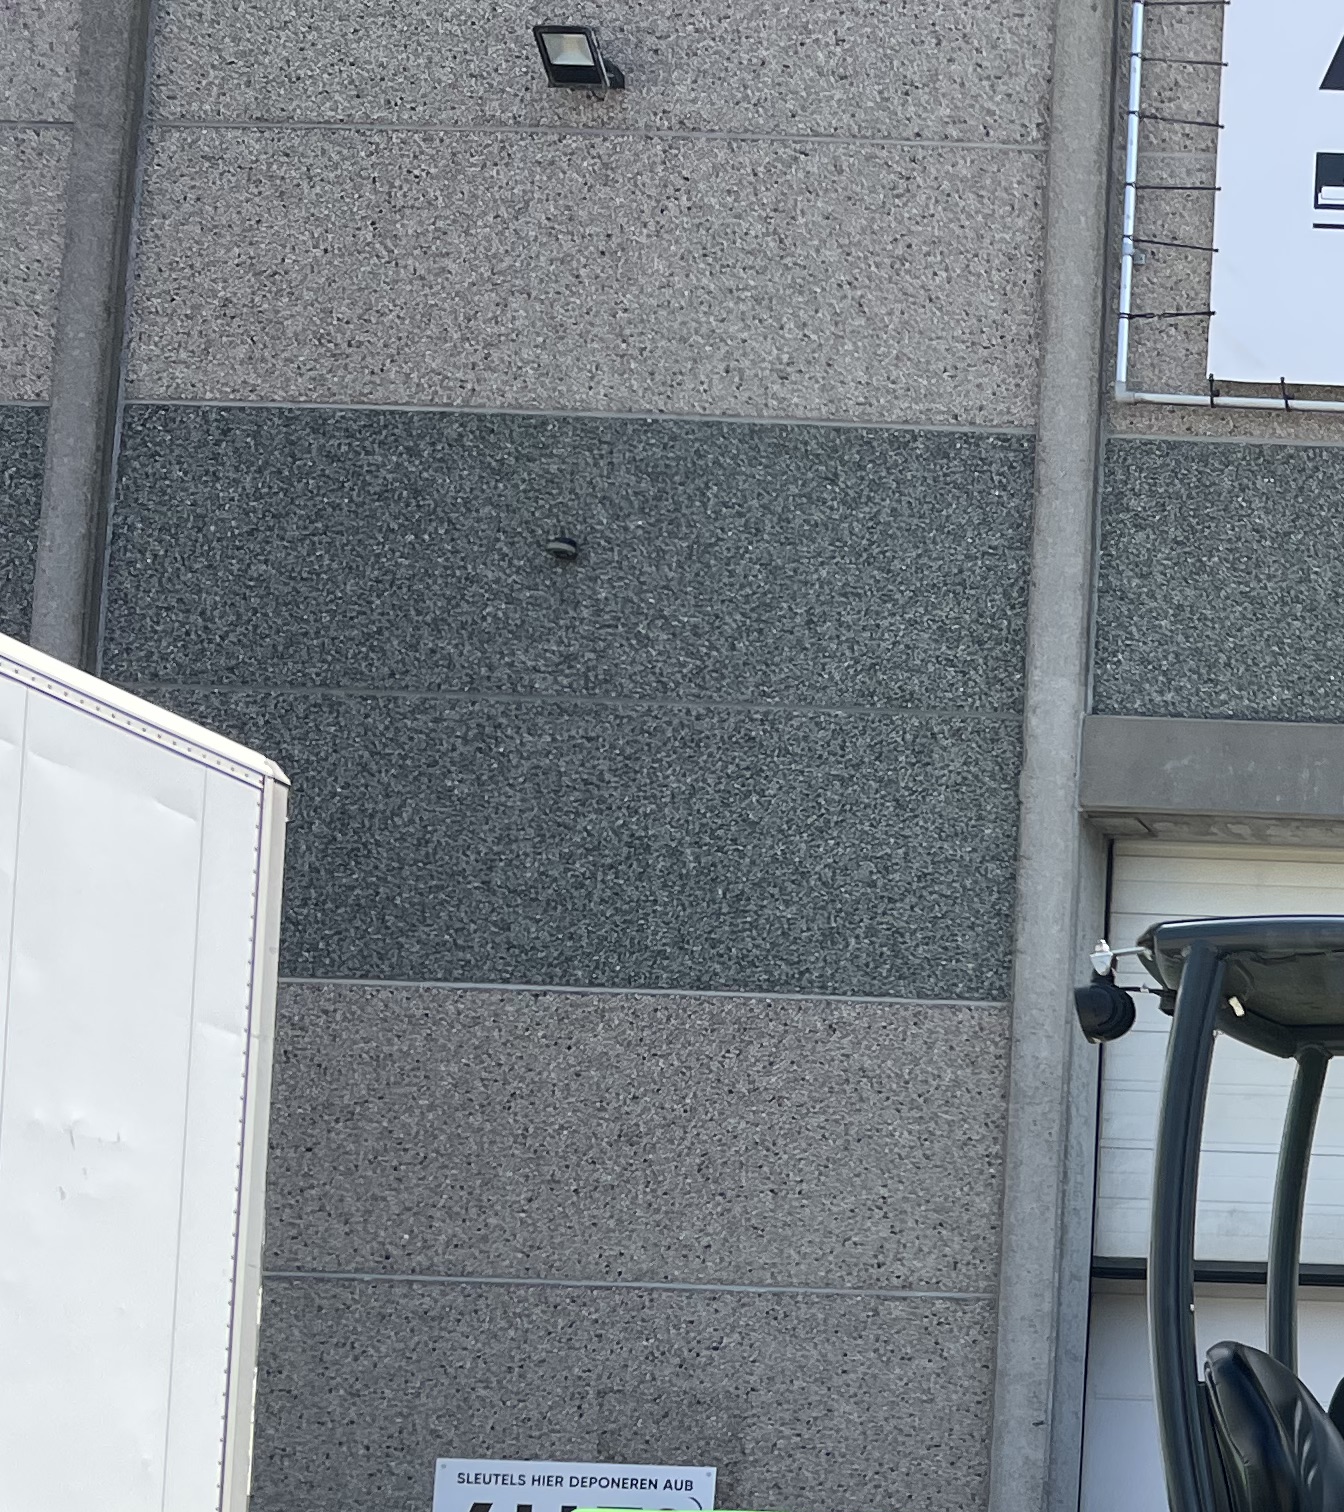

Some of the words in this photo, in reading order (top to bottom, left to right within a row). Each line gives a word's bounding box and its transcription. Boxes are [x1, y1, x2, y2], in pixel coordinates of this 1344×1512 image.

[457, 1472, 526, 1487] SLEUTELS
[531, 1475, 564, 1488] HIER
[569, 1476, 658, 1491] DEPONEREN
[663, 1478, 694, 1492] AUB
